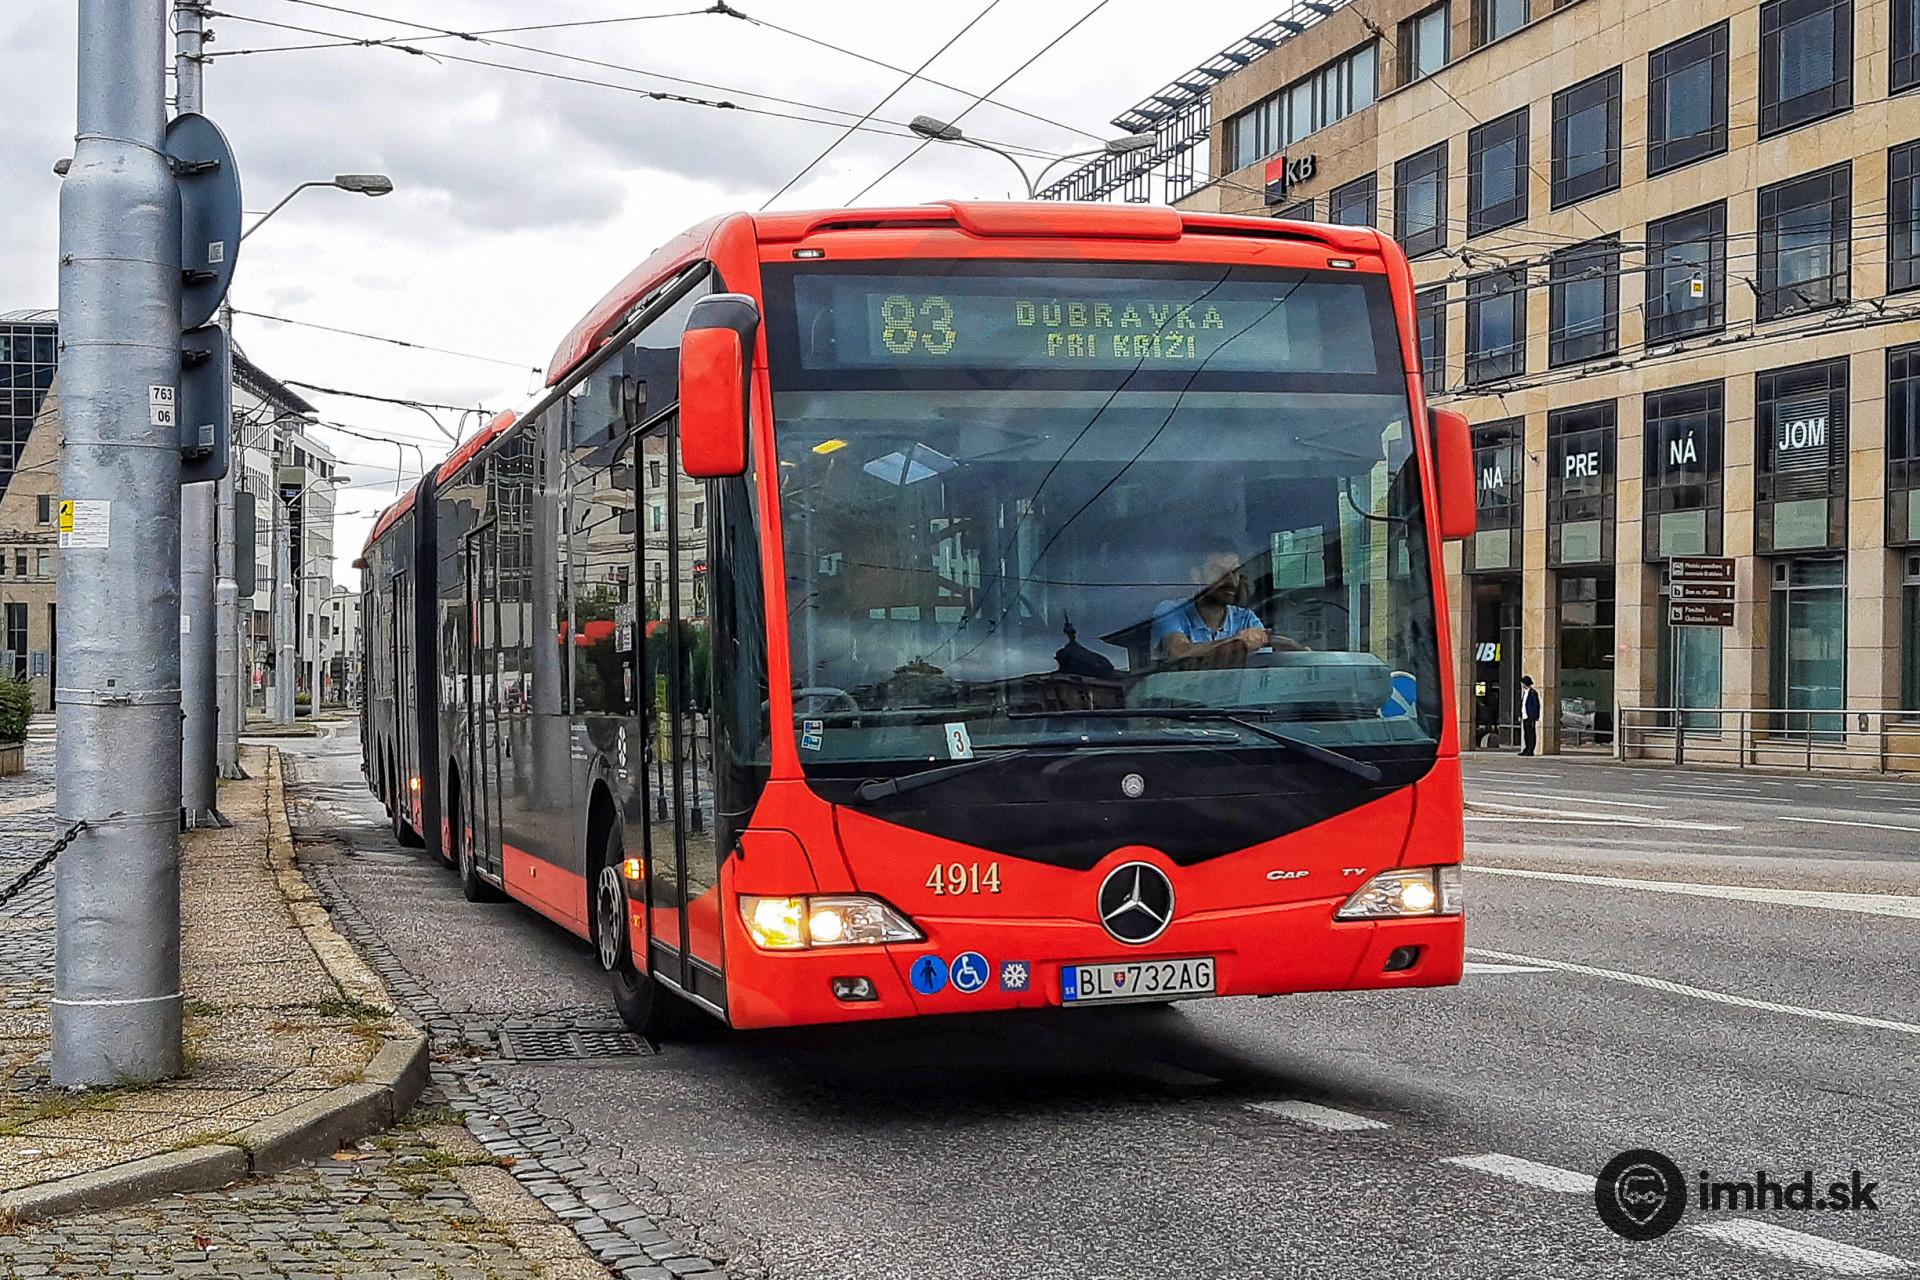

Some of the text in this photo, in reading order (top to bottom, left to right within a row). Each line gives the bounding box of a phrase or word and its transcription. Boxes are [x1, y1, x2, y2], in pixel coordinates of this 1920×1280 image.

[1285, 155, 1313, 186] KB
[881, 295, 957, 355] 83
[1047, 332, 1096, 357] PRI
[153, 387, 173, 401] 763
[157, 410, 171, 423] 06
[1483, 417, 1826, 490] NA PRE NÁ JOM
[952, 730, 965, 753] 3
[925, 862, 1002, 896] 4914
[1342, 868, 1367, 877] TY
